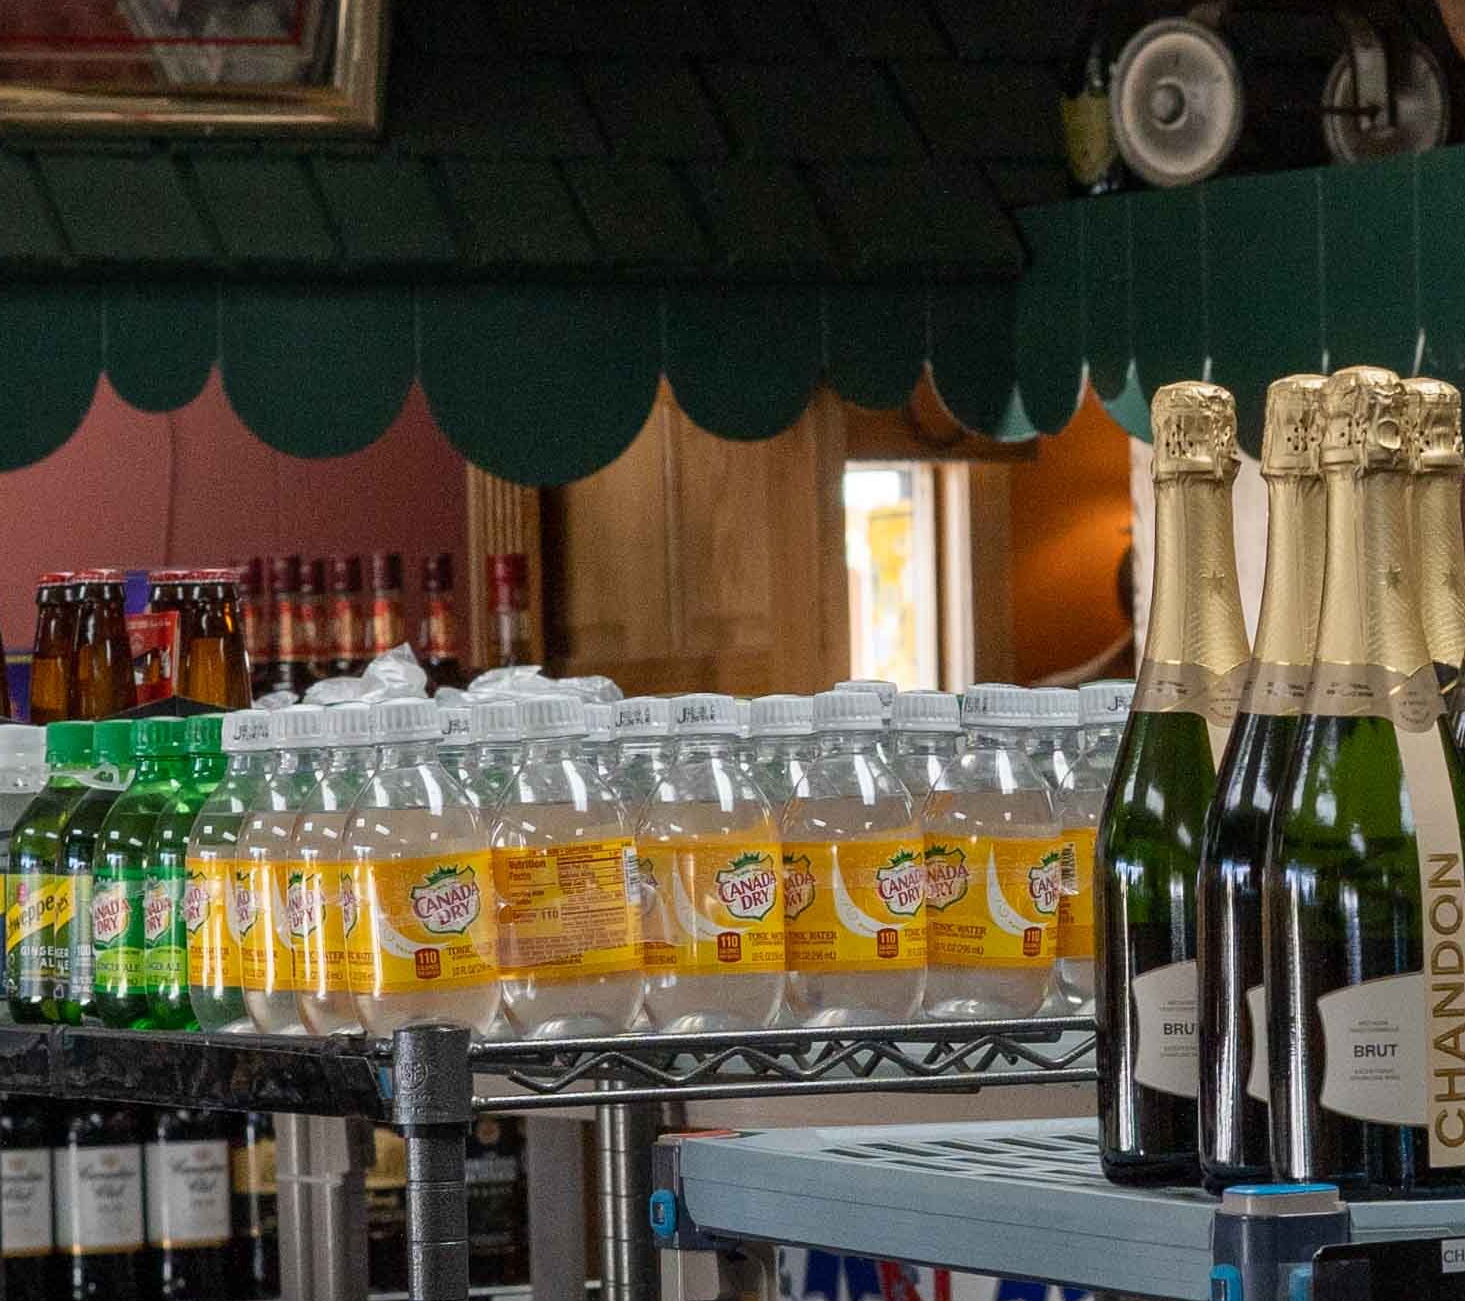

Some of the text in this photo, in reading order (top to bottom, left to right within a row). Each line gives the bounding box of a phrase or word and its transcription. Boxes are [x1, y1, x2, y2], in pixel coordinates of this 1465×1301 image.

[413, 883, 480, 913] CANADA
[439, 901, 471, 926] DRY
[418, 951, 437, 964] 110
[1353, 1044, 1398, 1058] BRUT
